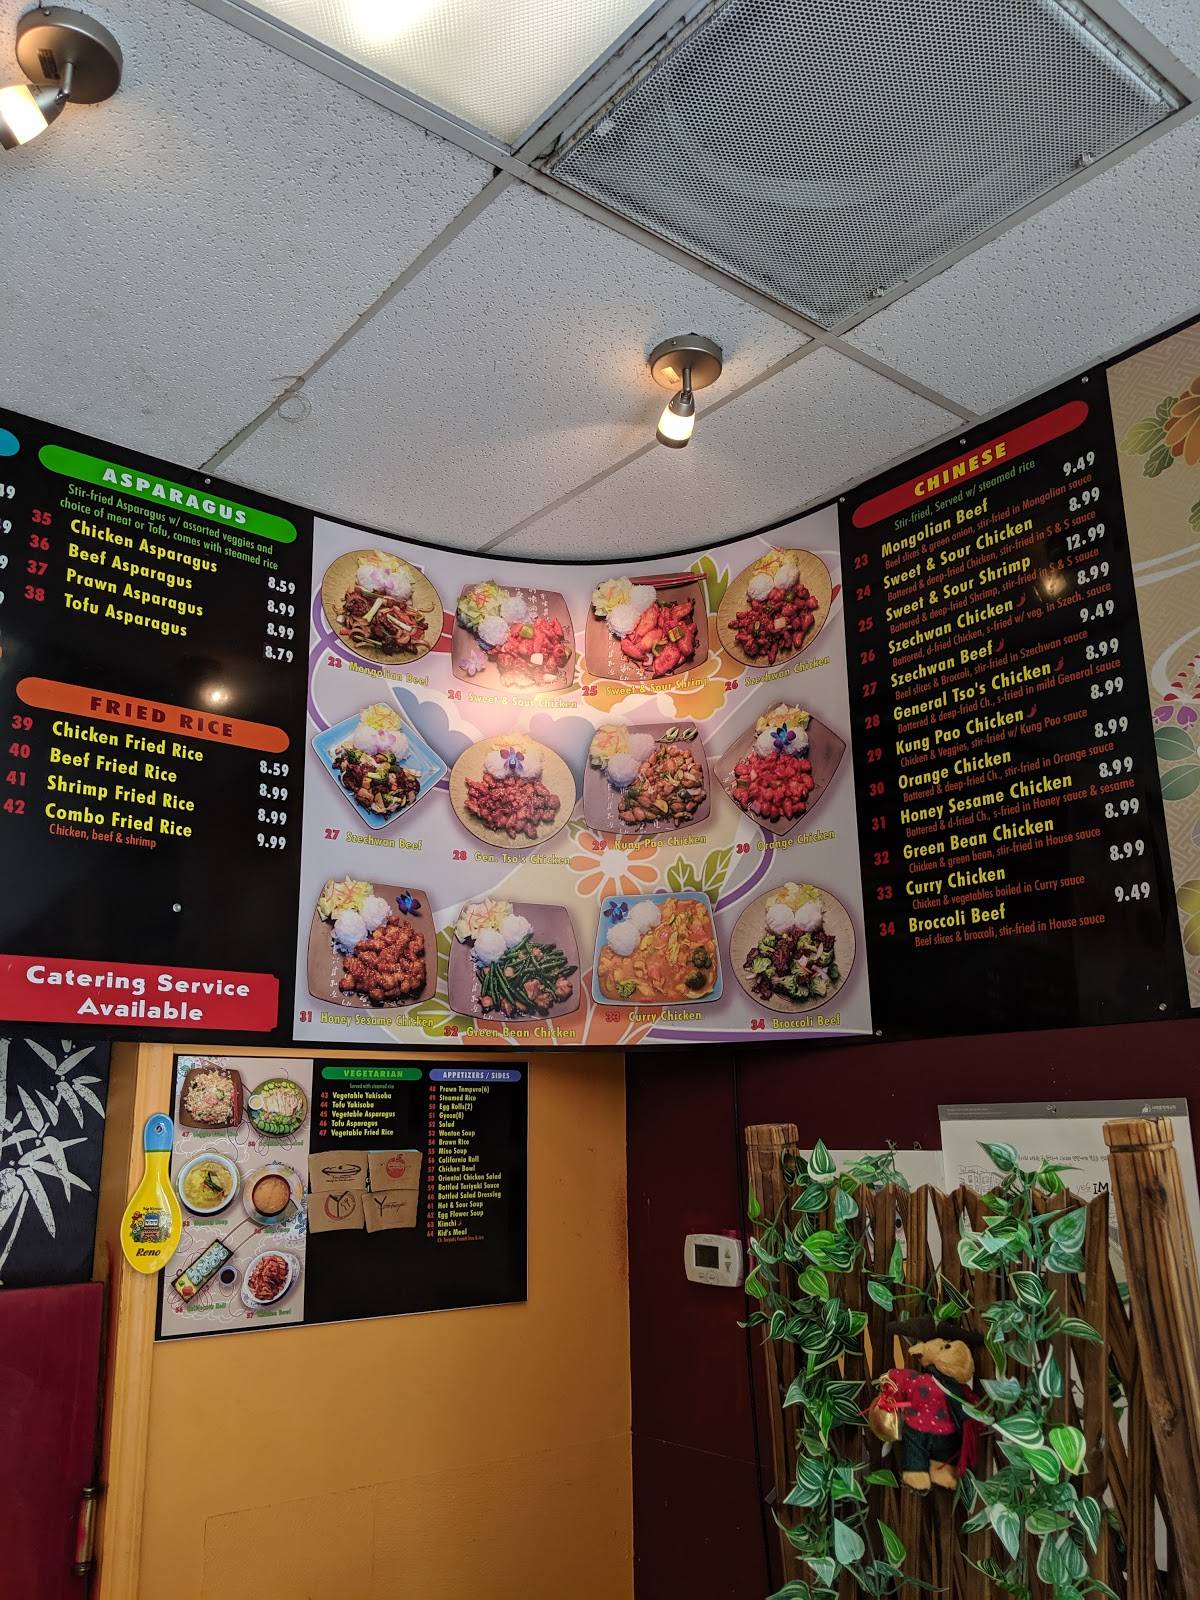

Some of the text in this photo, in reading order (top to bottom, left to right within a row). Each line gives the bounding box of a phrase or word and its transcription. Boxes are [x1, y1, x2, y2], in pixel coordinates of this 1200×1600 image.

[914, 442, 1006, 496] CHINESE
[1063, 451, 1095, 477] 9.49
[103, 468, 246, 524] ASPARAGUS
[894, 460, 1036, 531] Stir-fried, Served w/ steamed rice
[1069, 487, 1100, 512] 8.99
[68, 483, 273, 555] Stir-fried Asparagus w/ assorted veggies and
[882, 497, 988, 558] Mongolian Beef
[32, 509, 217, 572] 35 Chicken Asparagus
[60, 497, 278, 570] choice of meat or Tofu, comes with steamed rice
[1066, 523, 1105, 551] 12.99
[29, 534, 192, 589] 36 Beef Asparagus
[883, 519, 1033, 589] Sweet & Sour Chicken
[268, 576, 296, 595] 8.59
[1077, 562, 1109, 585] 8.99
[27, 560, 48, 575] 37
[67, 568, 117, 594] Prawn
[123, 583, 203, 616] Asparagus
[886, 557, 1031, 622] Sweet & Sour Shrimp
[25, 585, 45, 602] 38
[64, 593, 99, 614] Tofu
[105, 604, 187, 636] Asparagus
[267, 600, 295, 617] 8.99
[1080, 600, 1114, 623] 9.49
[267, 622, 294, 640] 8.99
[888, 600, 1013, 654] Szechwan Chicken
[265, 645, 293, 663] 8.79
[1086, 638, 1119, 660] 8.99
[891, 639, 993, 688] Szechwan Beef
[894, 664, 1051, 721] General Tso's Chicken
[1091, 677, 1123, 699] 8.99
[90, 696, 232, 737] FRIED RICE
[1094, 716, 1128, 738] 8.99
[11, 715, 203, 762] 39 Chicken Fried Rice
[867, 710, 1024, 763] 29 Kung Pao Chicken
[9, 743, 177, 783] 40 Beef Fried Rice
[260, 760, 289, 777] 8.59
[870, 752, 1011, 796] 30 Orange Chicken
[1099, 756, 1133, 778] 8.99
[6, 771, 195, 811] 41 Shrimp Fried Rice
[259, 783, 288, 801] 8.99
[872, 775, 1072, 831] 31 Honey Sesame Chicken
[3, 799, 192, 837] 42 Combo Fried Rice
[258, 808, 287, 825] 8.99
[1105, 798, 1139, 819] 8.99
[49, 823, 156, 850] Chicken, beef & shrimp
[257, 833, 286, 850] 9.99
[874, 819, 1054, 866] 32 Green Bean Chicken
[1110, 839, 1145, 861] 8.99
[877, 867, 1005, 900] 33 Curry Chicken
[1115, 882, 1150, 902] 9.49
[880, 902, 1005, 937] 34 Broccoli Beef
[915, 914, 1105, 947] Beef slices & broccoli, stir-fried in House sauce
[26, 965, 250, 997] Catering Service
[77, 997, 203, 1021] Available
[300, 1010, 434, 1028] 31 Honey Sesame Chicken
[628, 1011, 702, 1023] Curry Chicken
[750, 1014, 841, 1030] 34 Broccoli Beef
[466, 1026, 576, 1038] Green Bean Chicken
[343, 1070, 403, 1078] VEGETARIAN
[331, 1129, 362, 1137] Vegetable
[364, 1128, 380, 1136] Fried
[439, 1120, 455, 1128] Salad
[462, 1129, 475, 1137] Soup
[136, 1248, 161, 1257] Reno
